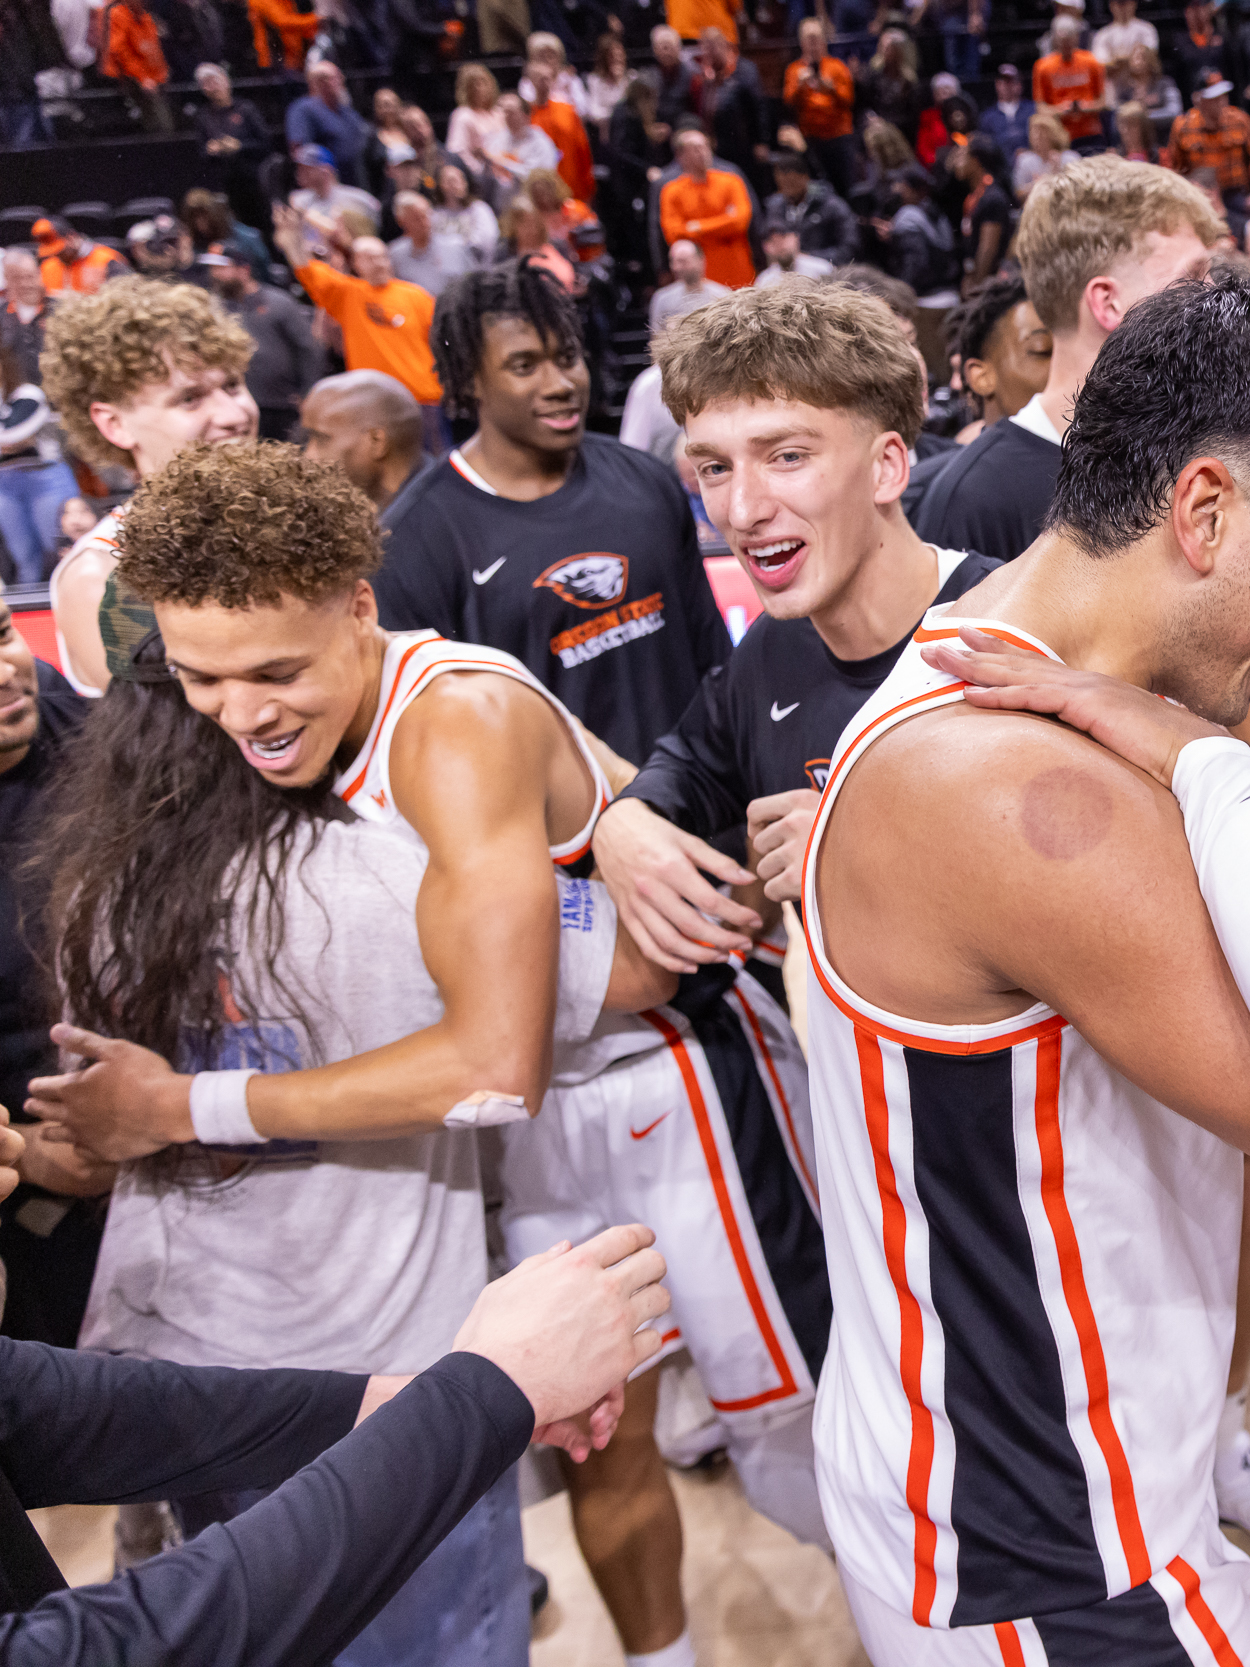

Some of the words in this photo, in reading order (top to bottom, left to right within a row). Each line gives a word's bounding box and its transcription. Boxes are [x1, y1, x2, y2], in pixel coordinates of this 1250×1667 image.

[549, 609, 621, 656] OREGON
[618, 592, 665, 623] STATE
[558, 610, 666, 669] BASKETBALL
